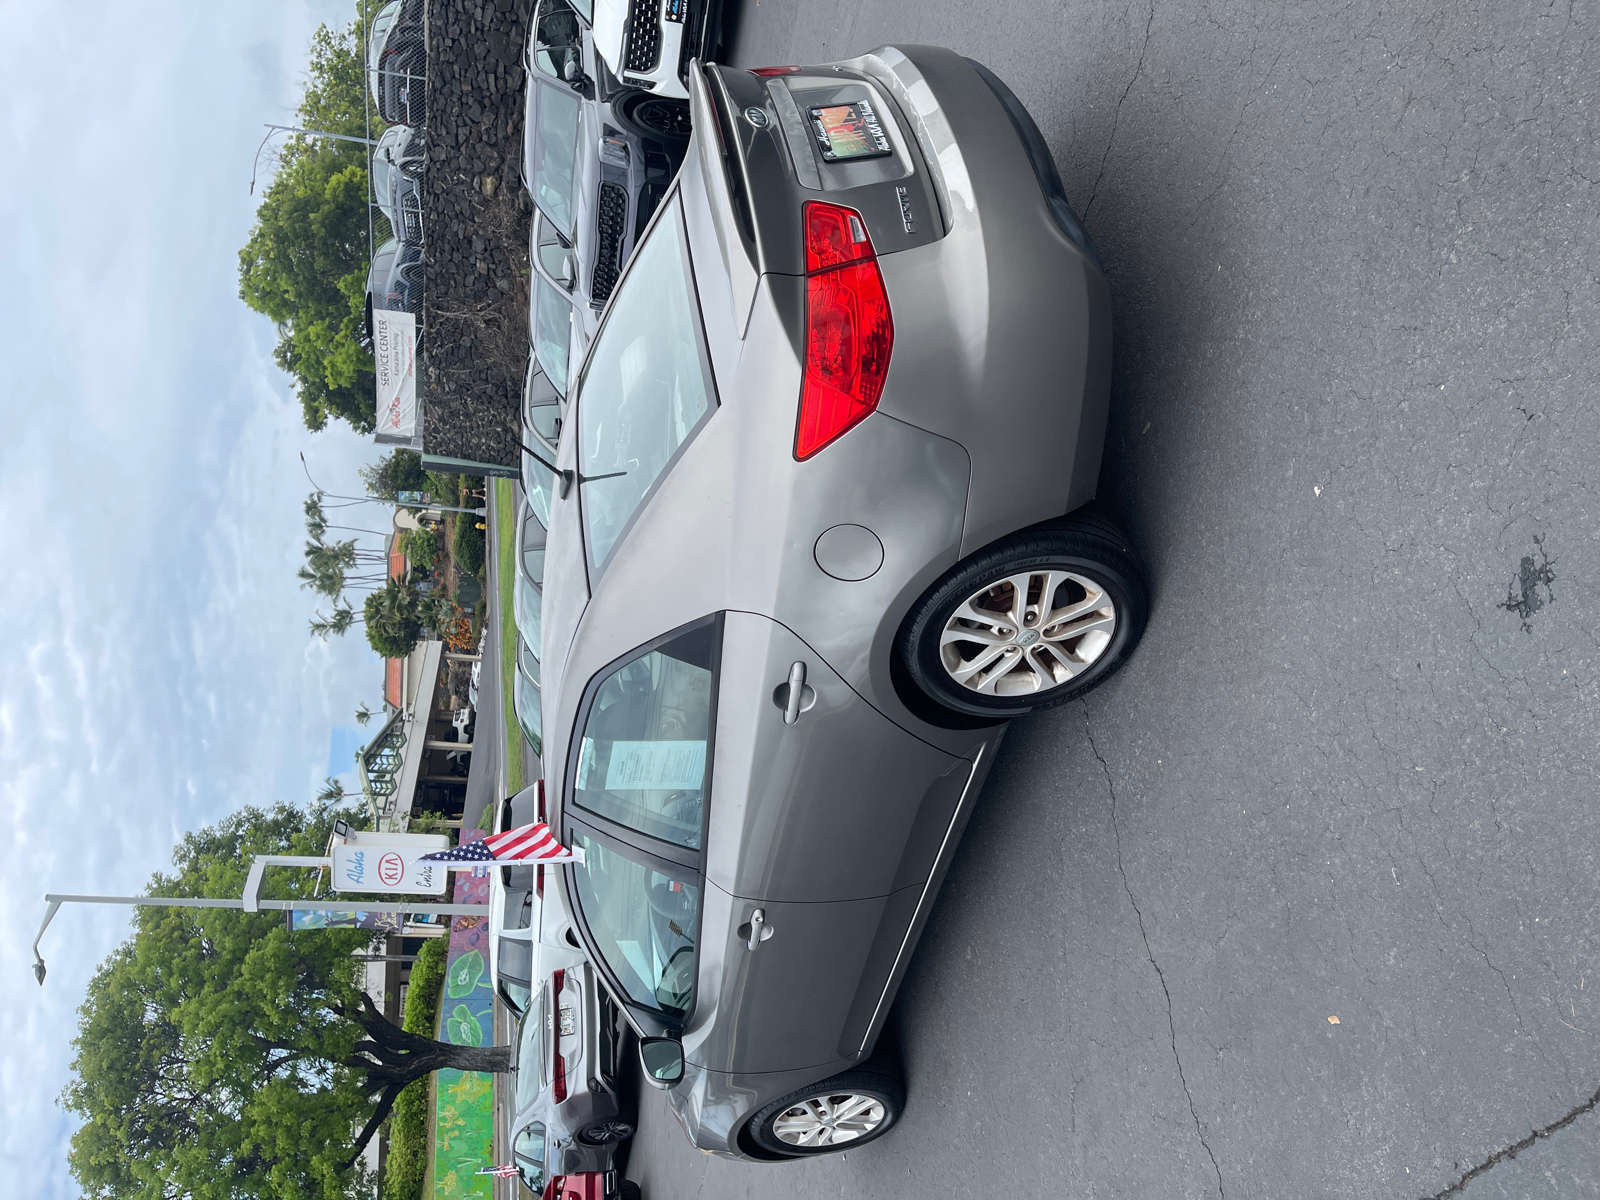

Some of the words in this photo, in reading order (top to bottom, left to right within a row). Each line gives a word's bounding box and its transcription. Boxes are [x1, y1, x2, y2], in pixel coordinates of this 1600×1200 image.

[813, 119, 831, 146] Hawaii
[895, 186, 916, 235] FORTE
[378, 319, 389, 352] CENTER
[392, 332, 400, 351] Pricing
[380, 353, 390, 387] SERVICE
[391, 396, 401, 410] Kia
[390, 410, 401, 429] Aloha
[346, 851, 365, 885] Aloha
[384, 858, 399, 880] KIA
